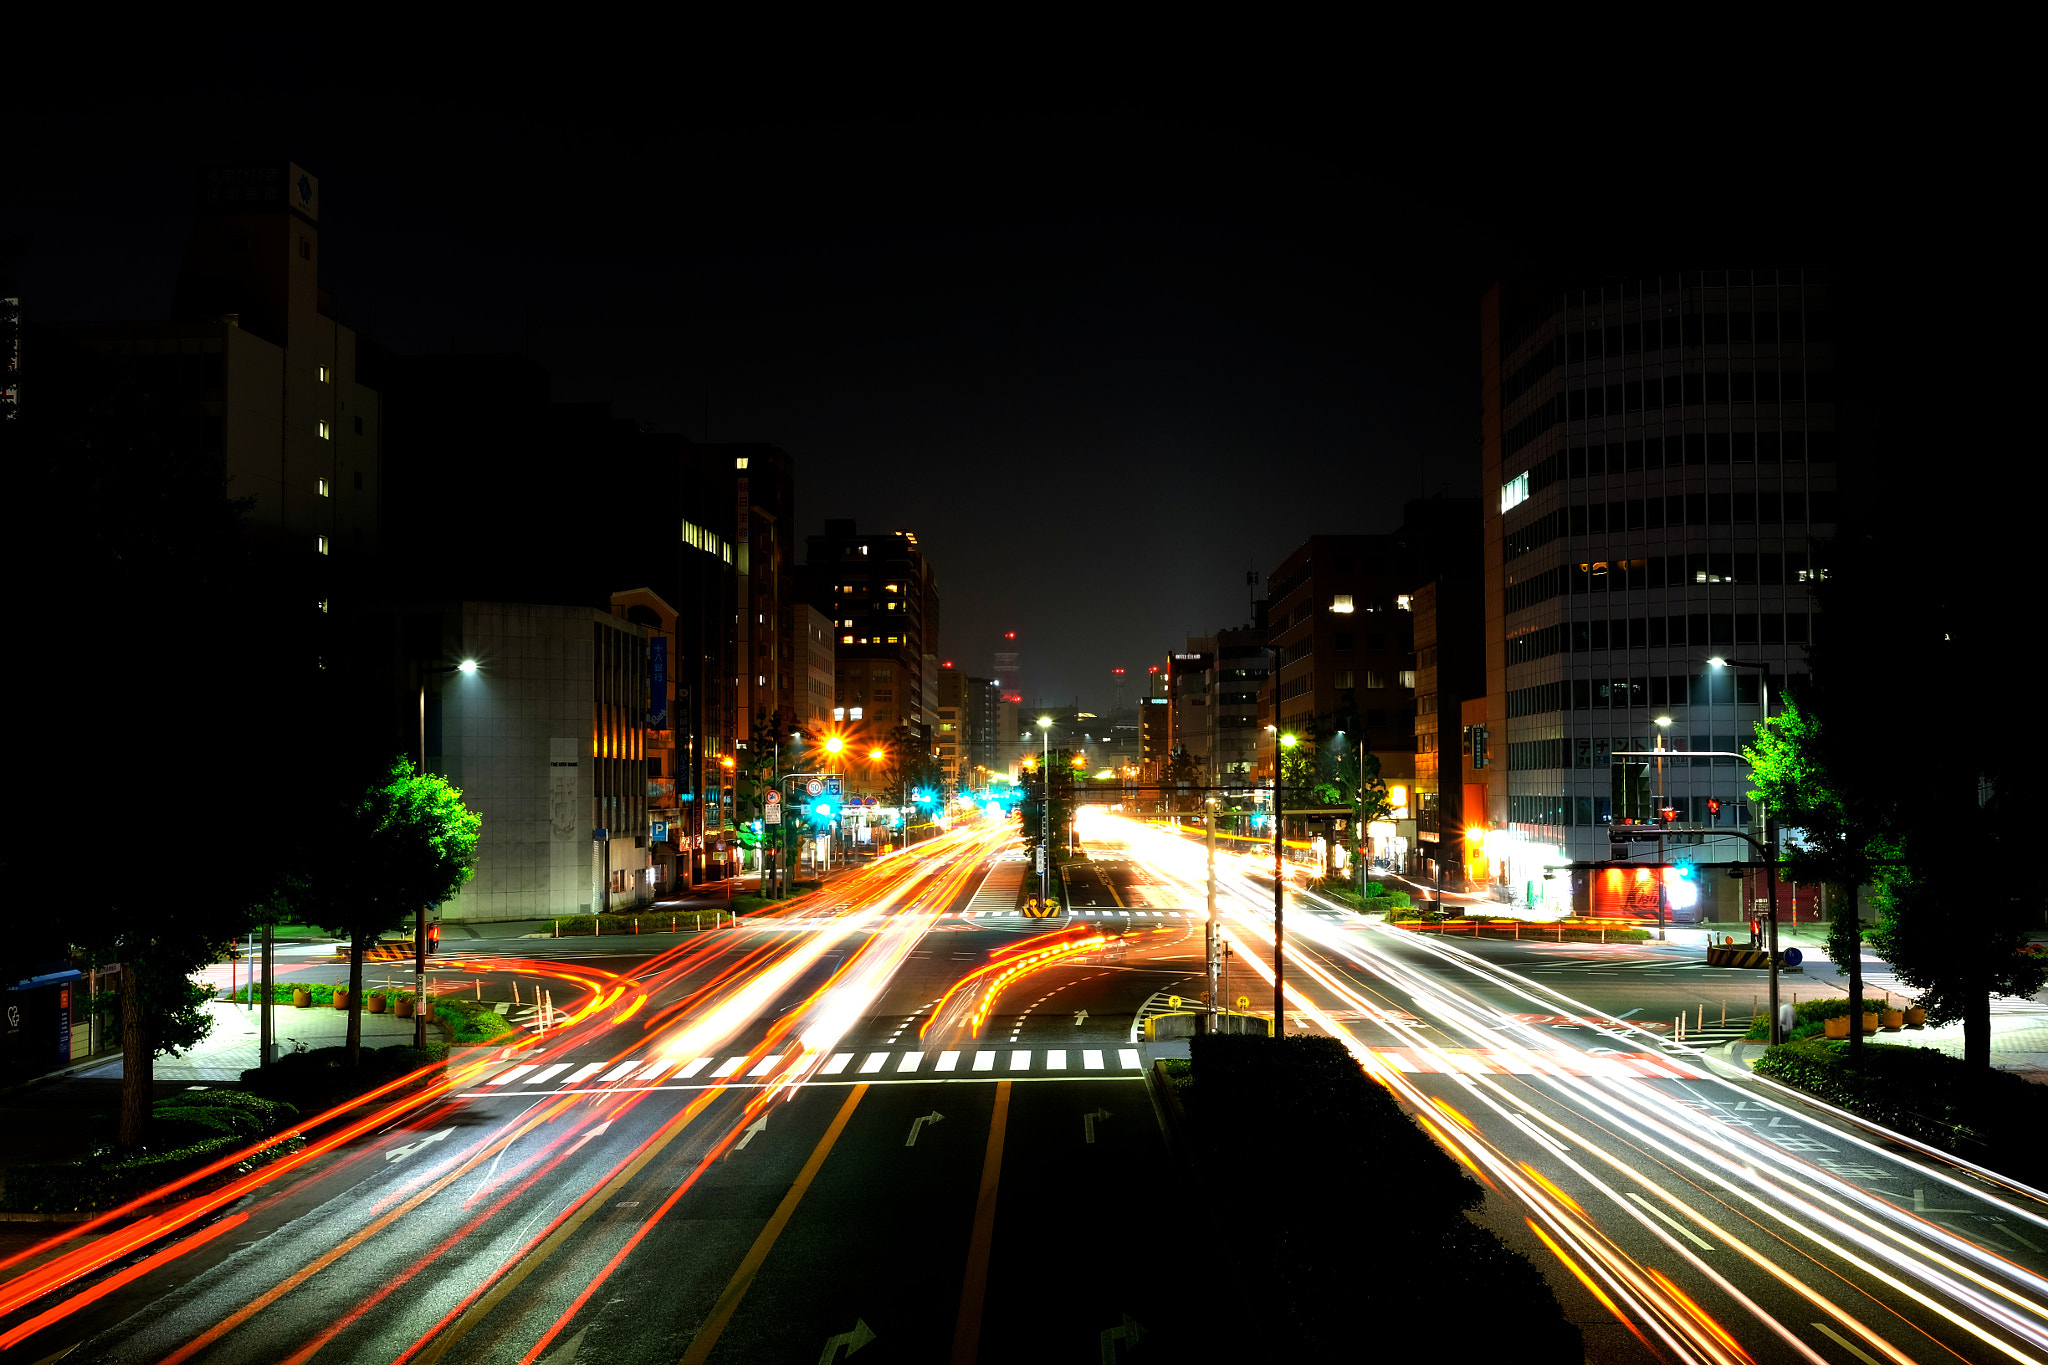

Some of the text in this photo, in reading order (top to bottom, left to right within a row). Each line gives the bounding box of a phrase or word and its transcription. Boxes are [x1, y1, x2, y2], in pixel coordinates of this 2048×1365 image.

[654, 644, 663, 682] 十八銀行
[810, 784, 820, 792] 50
[656, 824, 664, 835] P
